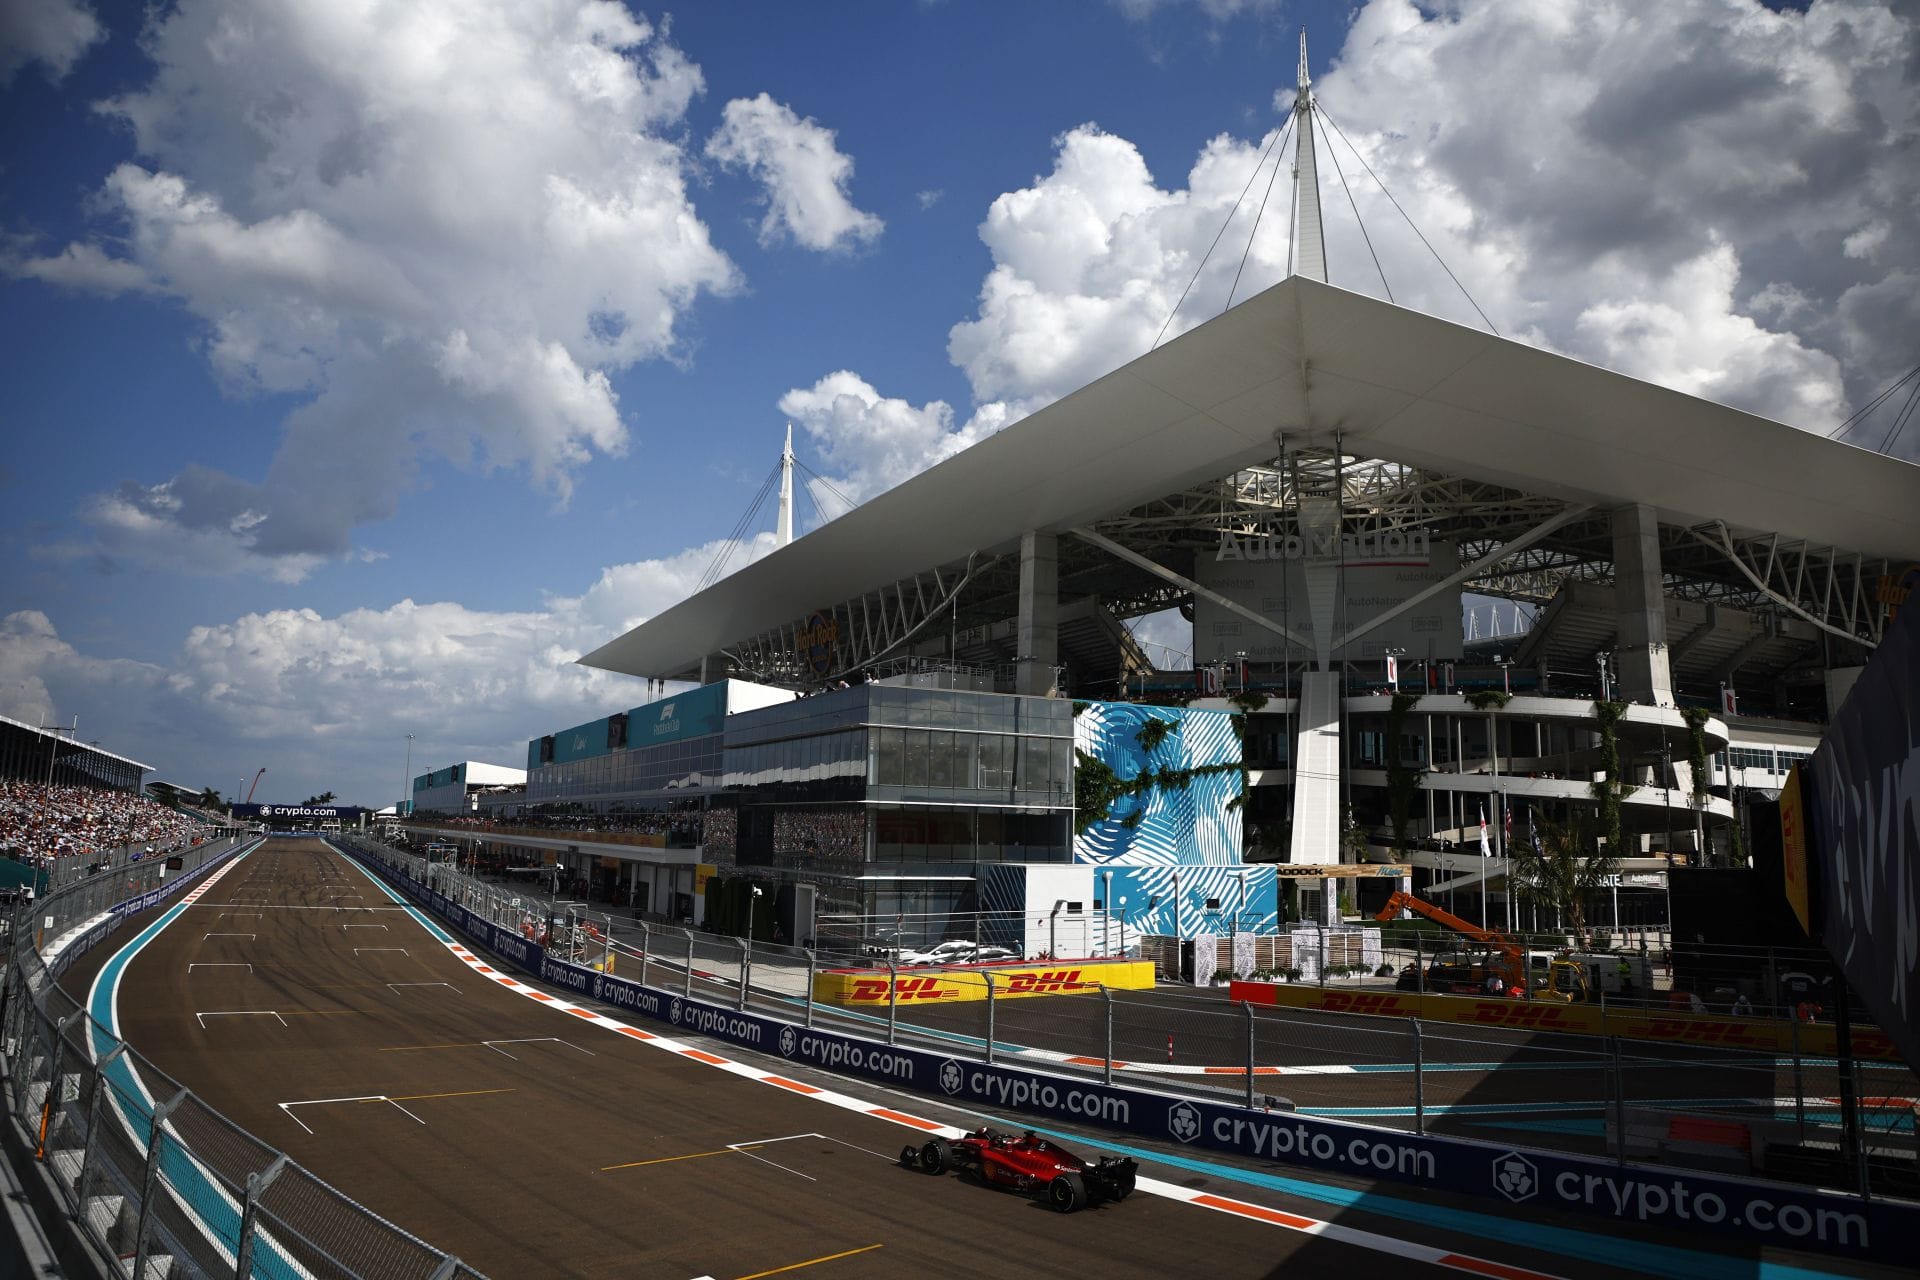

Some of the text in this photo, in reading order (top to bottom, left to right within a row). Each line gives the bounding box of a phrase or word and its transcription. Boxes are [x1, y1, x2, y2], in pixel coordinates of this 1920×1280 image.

[1216, 529, 1430, 562] AutoNation
[274, 806, 336, 818] crypto.com
[499, 934, 527, 961] crypto.com
[547, 963, 586, 989] crypto.com
[850, 978, 944, 1000] DHL
[1006, 970, 1085, 994] DHL
[604, 982, 658, 1013] crypto.com
[1321, 992, 1407, 1016] DHL
[684, 1006, 761, 1043] crypto.com
[1474, 1003, 1569, 1029] DHL
[1648, 1019, 1759, 1045] DHL
[801, 1036, 913, 1079] crypto.com
[971, 1071, 1129, 1123] crypto.com
[1212, 1116, 1435, 1179] crypto.com
[1555, 1170, 1869, 1247] crypto.com
